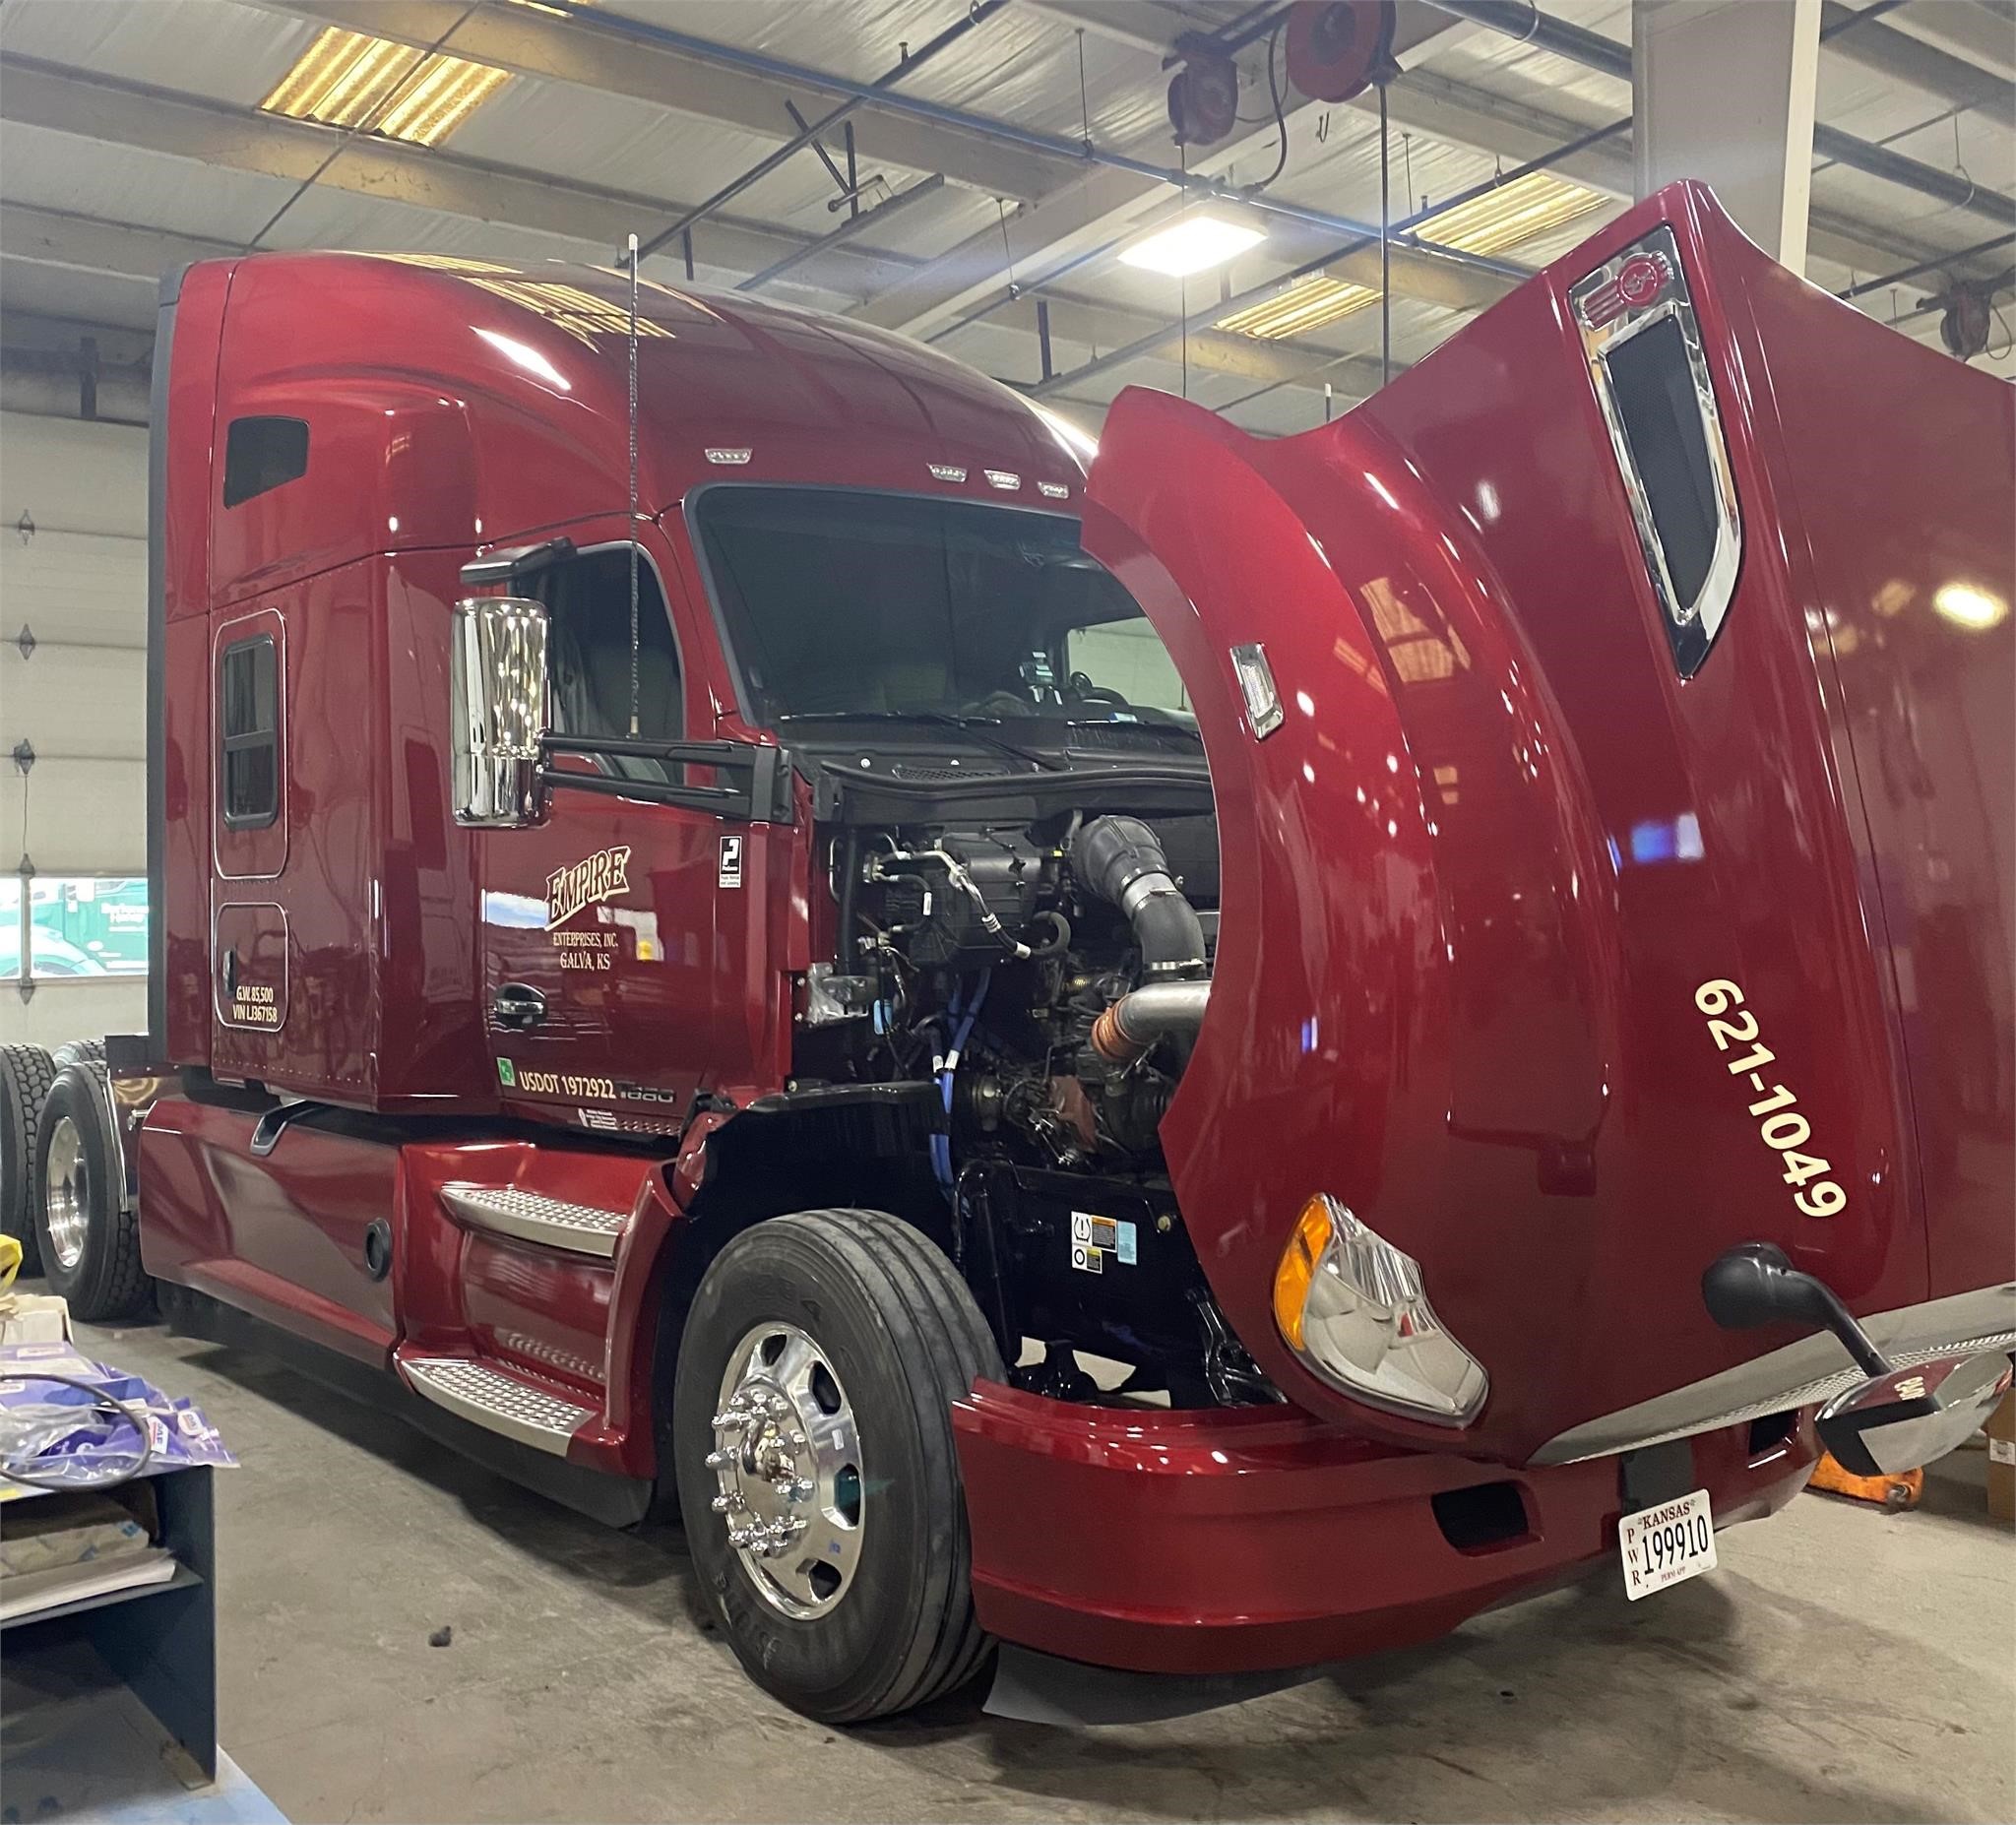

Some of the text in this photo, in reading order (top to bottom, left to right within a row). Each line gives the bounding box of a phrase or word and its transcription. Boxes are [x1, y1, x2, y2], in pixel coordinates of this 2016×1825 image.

[544, 846, 631, 932] EMPIRE
[552, 932, 619, 948] ENTERPRISES, INC.
[560, 951, 610, 971] GALVA, KS
[251, 986, 274, 1004] 85,500
[232, 1004, 246, 1020] VIN
[519, 1071, 560, 1095] USDOT
[561, 1076, 616, 1100] 1972922
[1694, 978, 1847, 1218] 621-1049
[1642, 1501, 1690, 1531] KANSAS
[1642, 1514, 1709, 1576] 199910
